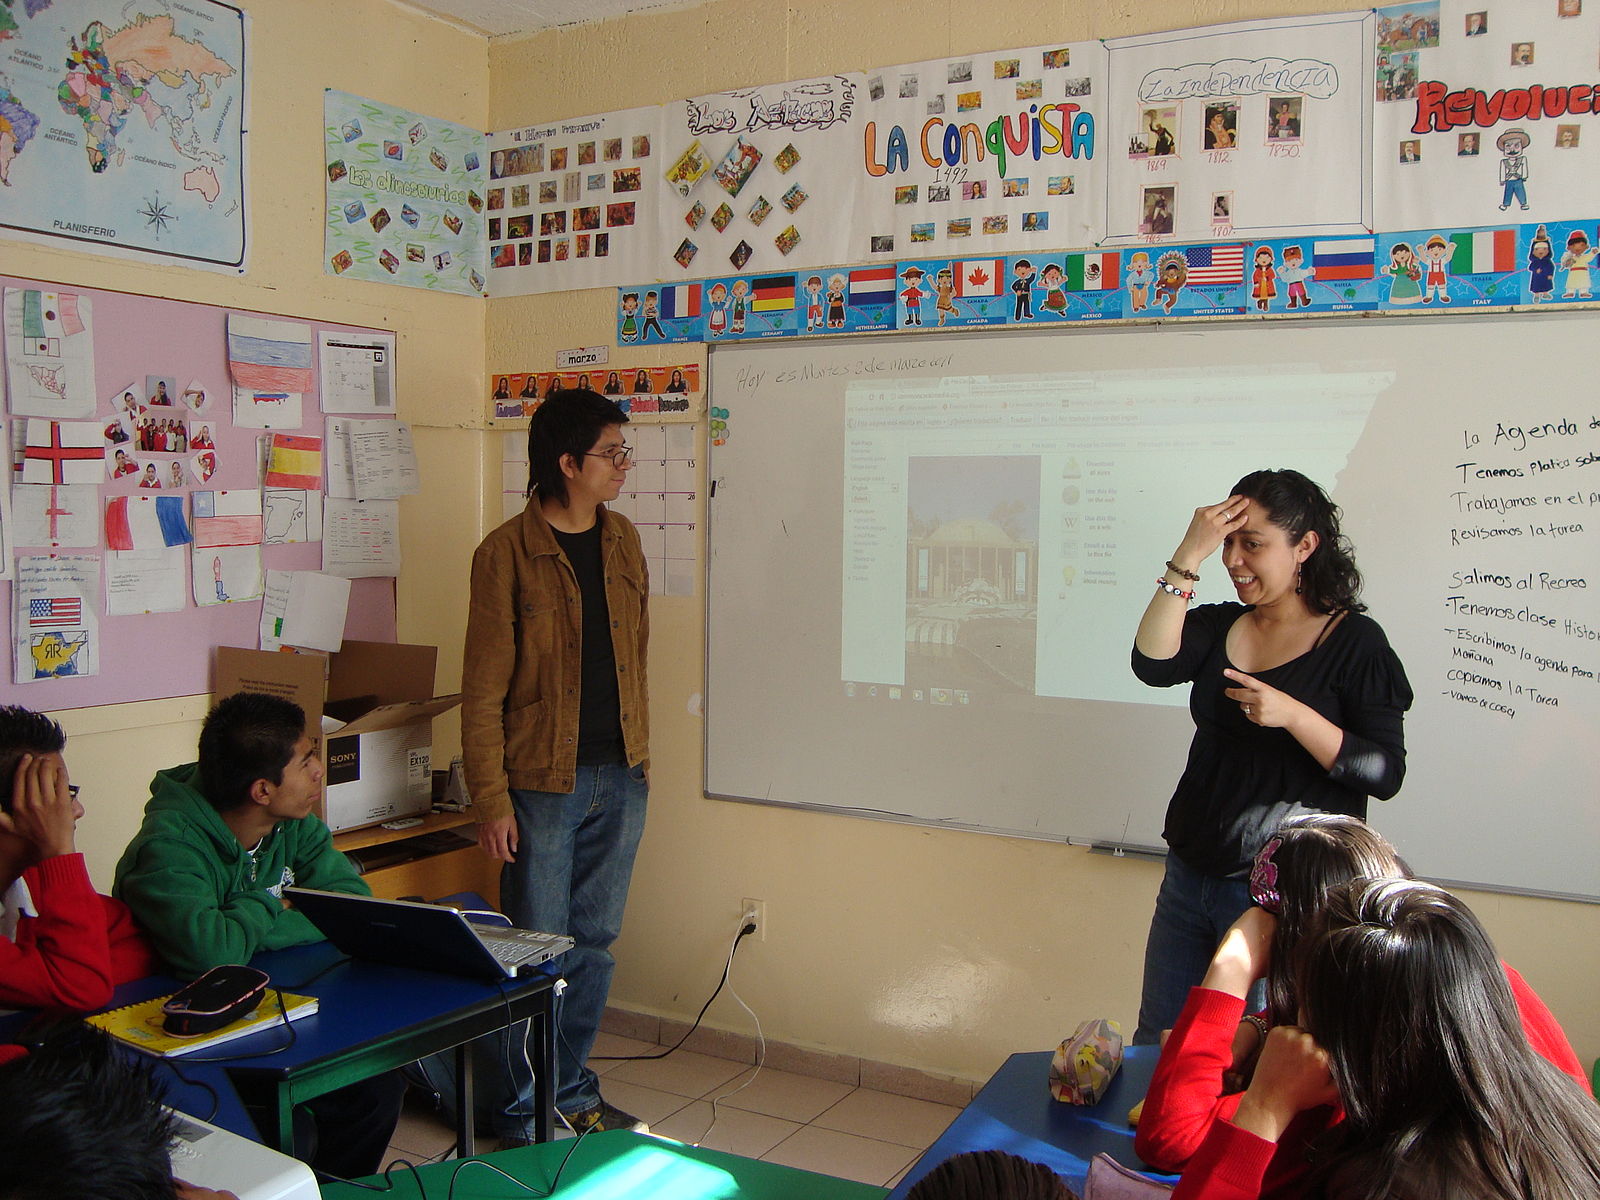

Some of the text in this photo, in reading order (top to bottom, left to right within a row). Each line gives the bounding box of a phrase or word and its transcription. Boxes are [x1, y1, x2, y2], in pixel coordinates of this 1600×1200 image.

[864, 121, 909, 177] LA
[933, 168, 968, 185] 1492
[53, 219, 116, 238] PLANISFERIO
[568, 354, 597, 364] marzo
[1464, 430, 1480, 450] La
[1494, 418, 1578, 451] Agenda
[1456, 463, 1525, 484] Tenemos
[1450, 491, 1537, 515] Trabajamos
[1544, 495, 1562, 505] en
[1567, 491, 1584, 506] el
[1451, 525, 1523, 546] Revisamos
[1530, 525, 1545, 537] la
[1448, 568, 1587, 590] Salimos al Recreo
[1534, 655, 1568, 671] agenda
[330, 752, 357, 764] SONY
[410, 755, 430, 766] EX120
